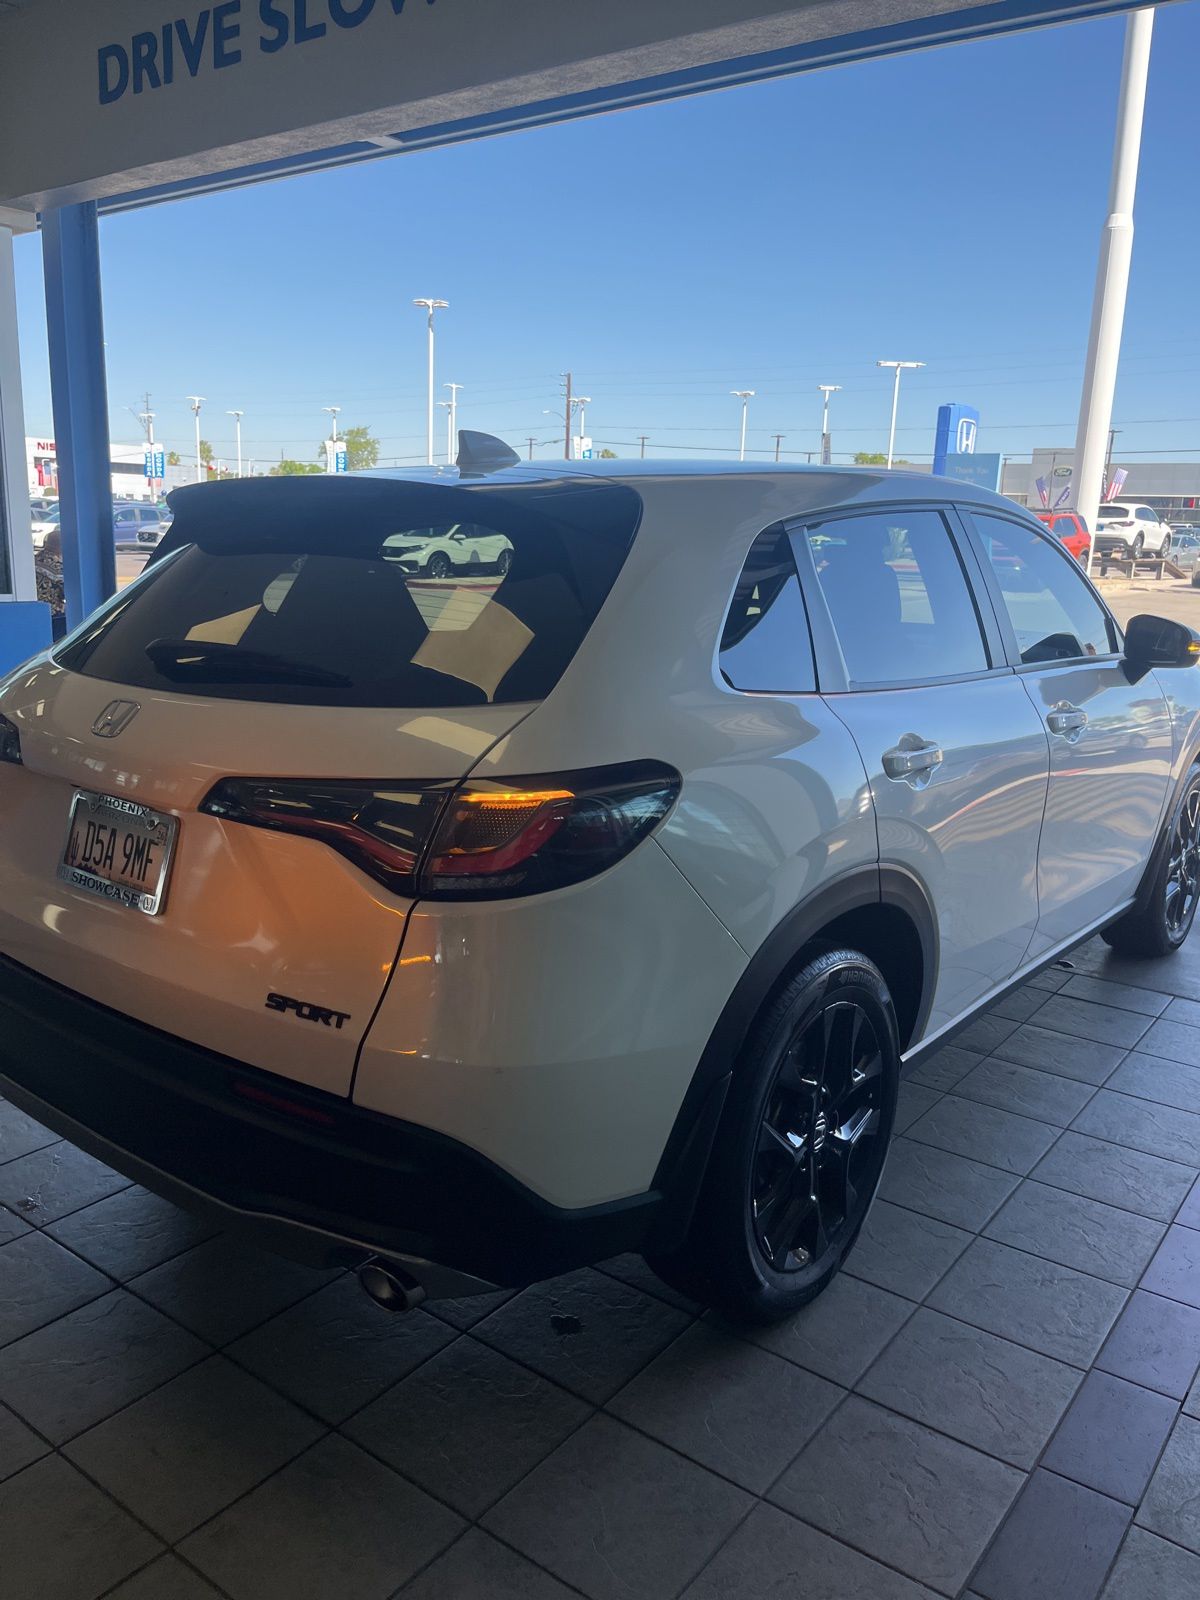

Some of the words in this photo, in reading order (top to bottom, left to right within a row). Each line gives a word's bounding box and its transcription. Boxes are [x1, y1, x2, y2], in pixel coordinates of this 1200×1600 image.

[97, 0, 242, 105] DRIVE
[98, 796, 149, 817] PHOENIX
[81, 820, 118, 871] D5A
[120, 832, 159, 882] 9MF
[72, 871, 140, 905] SHOWCASE
[265, 992, 351, 1029] SPORT
